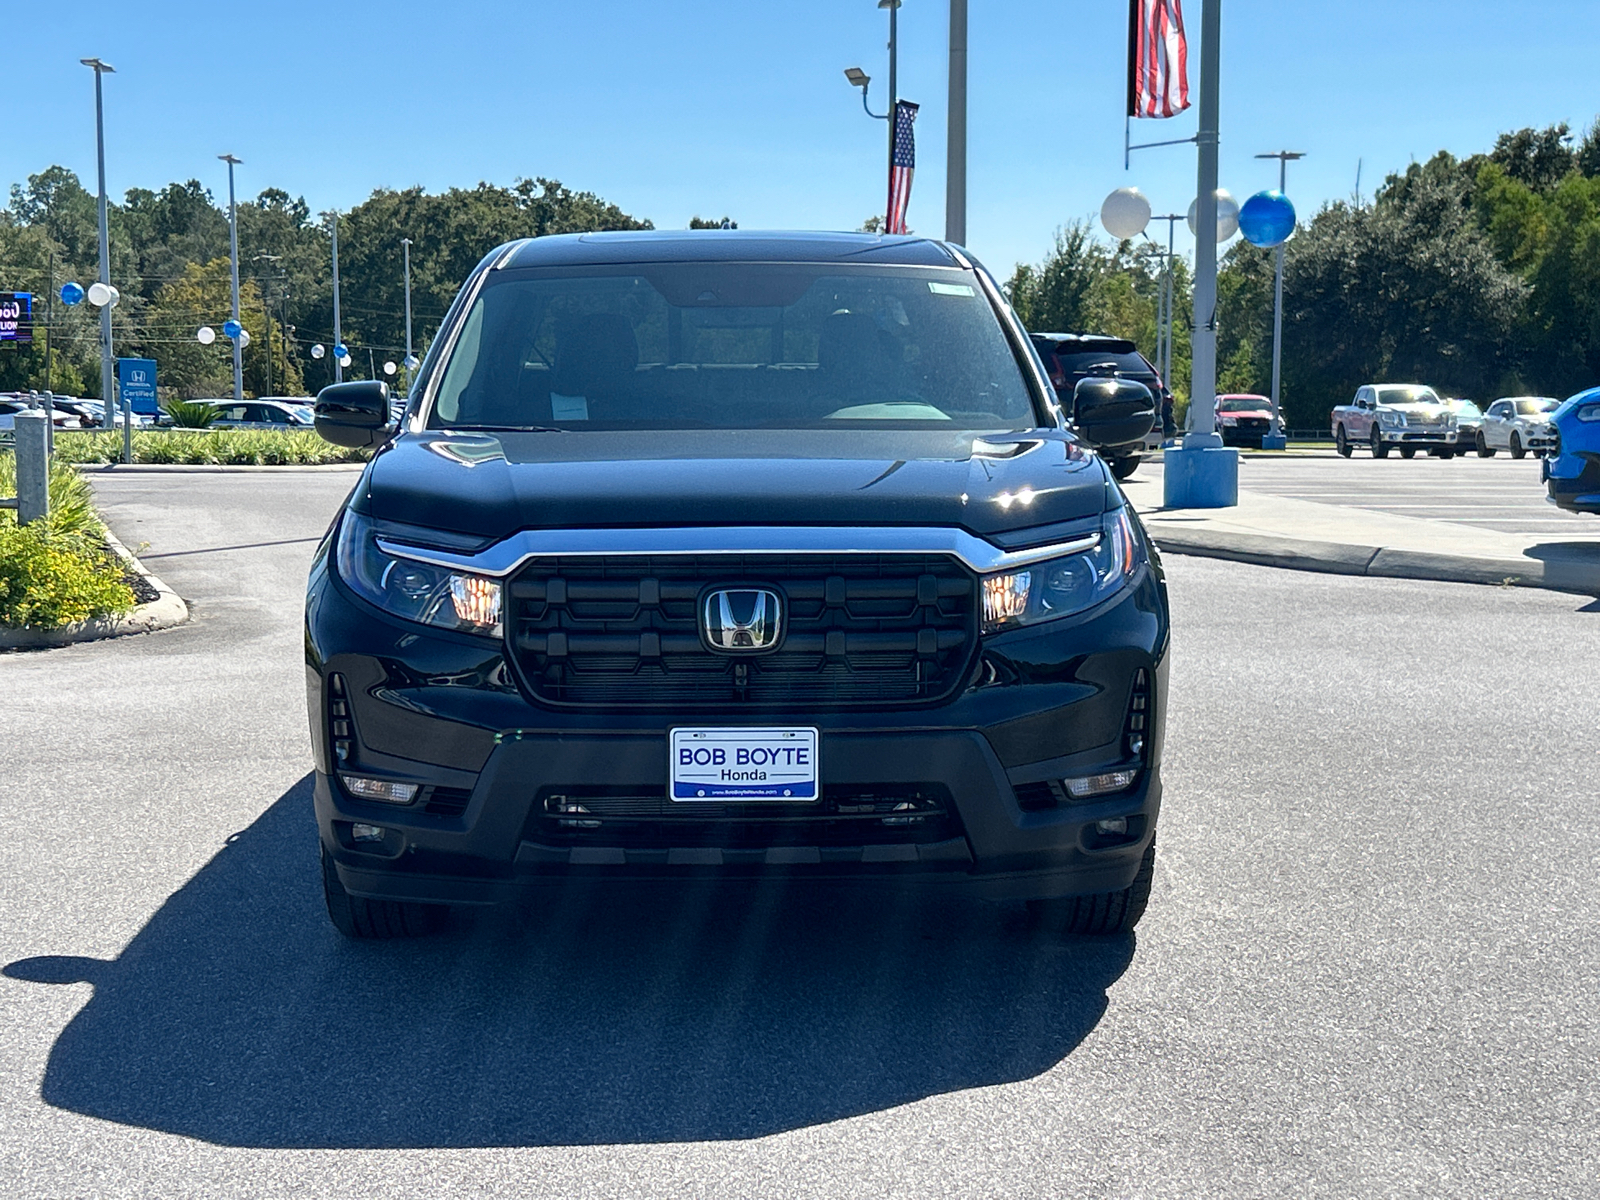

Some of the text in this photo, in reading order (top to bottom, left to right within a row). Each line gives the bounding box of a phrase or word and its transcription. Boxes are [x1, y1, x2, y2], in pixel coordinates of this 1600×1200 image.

[123, 389, 155, 398] Certified
[679, 748, 809, 766] BOB BOYTE
[720, 769, 767, 781] Honda
